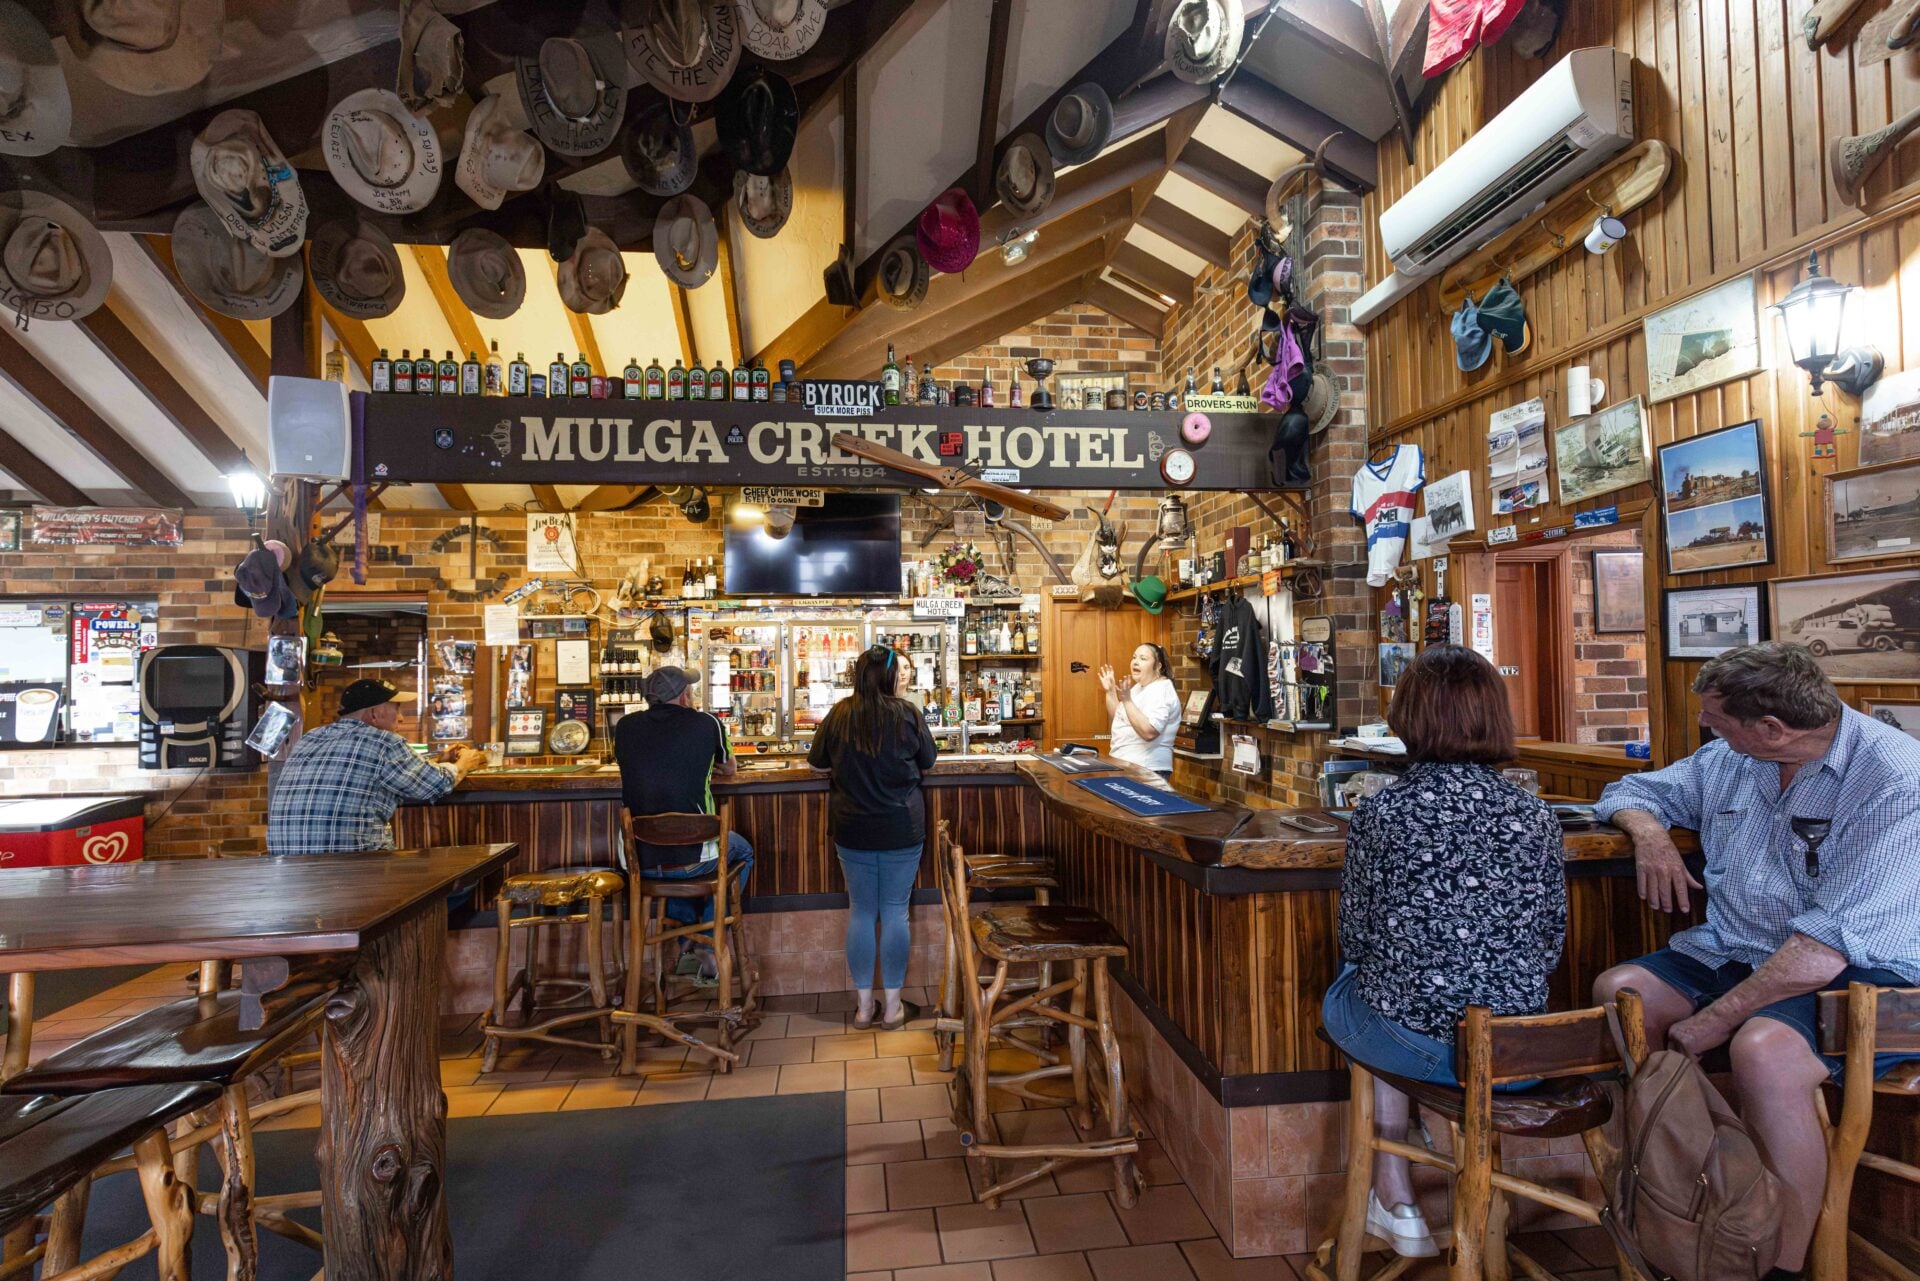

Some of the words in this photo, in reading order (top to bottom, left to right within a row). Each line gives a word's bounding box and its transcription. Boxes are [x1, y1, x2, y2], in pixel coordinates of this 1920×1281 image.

[747, 22, 790, 51] BOAR
[795, 11, 822, 43] DAVE
[668, 68, 708, 86] THE
[707, 5, 735, 76] PUBLICAN
[525, 64, 552, 126] LANCE
[567, 79, 622, 138] HAWLEY
[330, 113, 344, 160] GEURIE
[262, 202, 295, 234] WILSON
[805, 383, 881, 407] BYROCK
[1187, 398, 1257, 411] DROVERS-RUN
[816, 406, 836, 414] SUCK
[836, 406, 854, 415] MORE
[855, 407, 872, 416] PISS
[521, 416, 729, 464] MULGA
[748, 421, 941, 465] CREEK
[963, 425, 1144, 468] HOTEL
[743, 487, 769, 497] CHEER
[783, 489, 795, 497] THE
[795, 489, 821, 498] WORST
[745, 495, 752, 503] IS
[752, 495, 765, 504] YET
[767, 496, 776, 504] TO
[39, 512, 100, 524] WILLOUGHBY'S
[102, 513, 145, 524] BUTCHERY
[532, 516, 548, 532] JIM
[549, 515, 571, 530] BEAM
[1031, 522, 1052, 530] SALE
[1054, 586, 1077, 594] XXXX
[916, 600, 939, 609] MULGA
[940, 600, 963, 609] CREEK
[927, 608, 951, 616] HOTEL
[96, 620, 136, 629] POWERS
[97, 637, 135, 648] LIGHT
[925, 713, 939, 721] DRY
[1328, 763, 1335, 771] B
